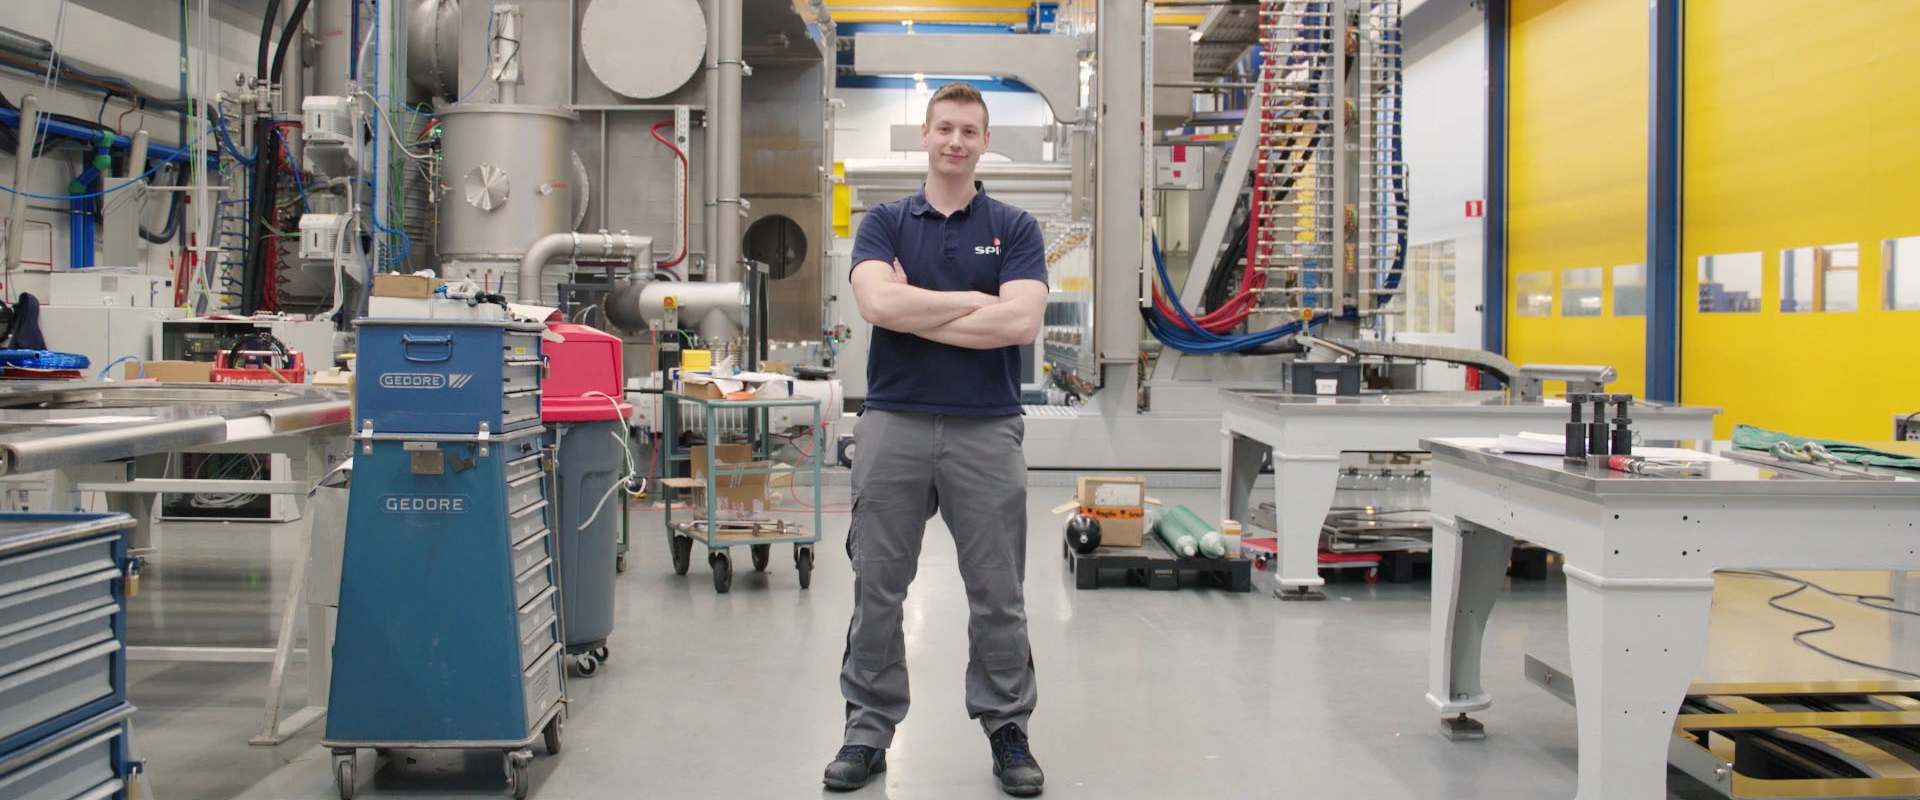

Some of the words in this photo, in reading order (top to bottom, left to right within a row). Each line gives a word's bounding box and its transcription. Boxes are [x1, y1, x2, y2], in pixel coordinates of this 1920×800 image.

[974, 246, 1001, 255] SPI
[384, 375, 440, 386] GEDORE
[386, 497, 464, 511] GEDORE
